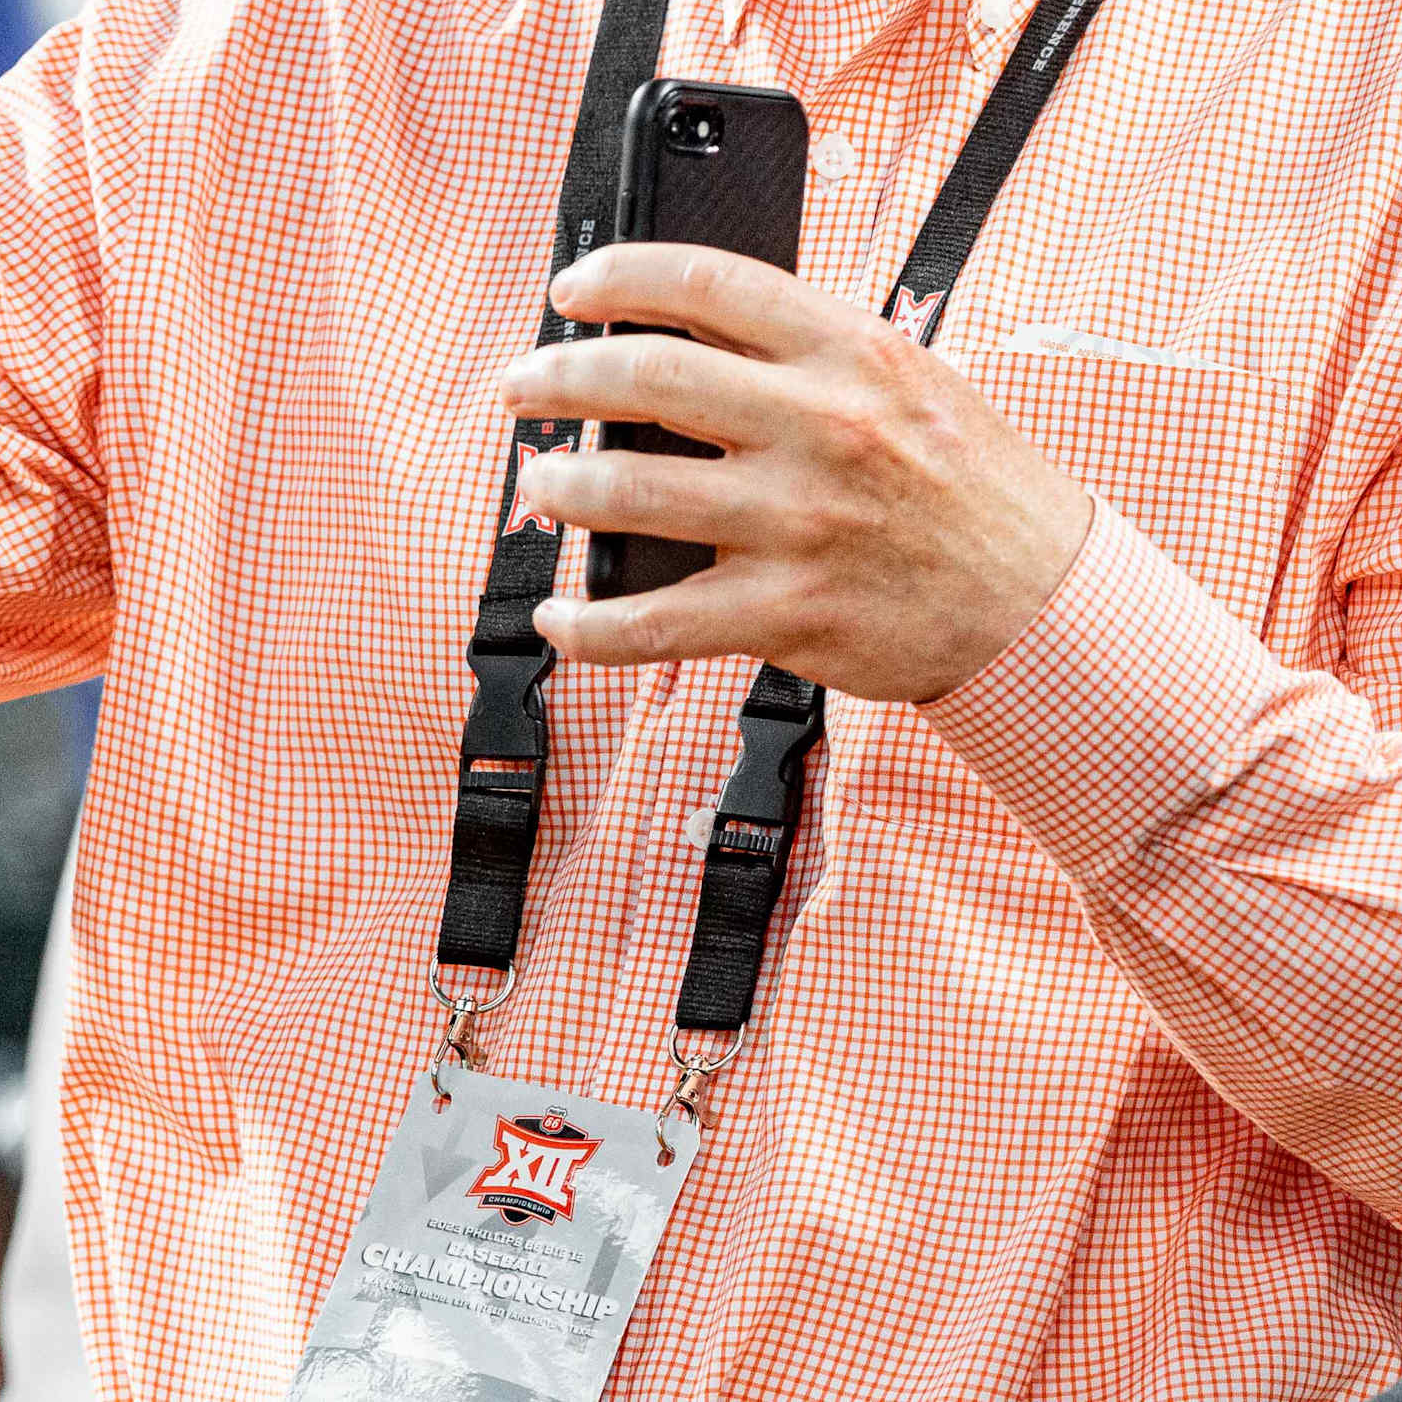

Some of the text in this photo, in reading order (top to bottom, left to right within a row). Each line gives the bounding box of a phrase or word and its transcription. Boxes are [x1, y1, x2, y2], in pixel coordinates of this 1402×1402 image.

[544, 1116, 562, 1128] 66
[488, 1195, 551, 1216] CHAMPIONSHIP
[447, 1241, 548, 1279] BASEBALL
[361, 1242, 621, 1321] CHAMPIONSHIP
